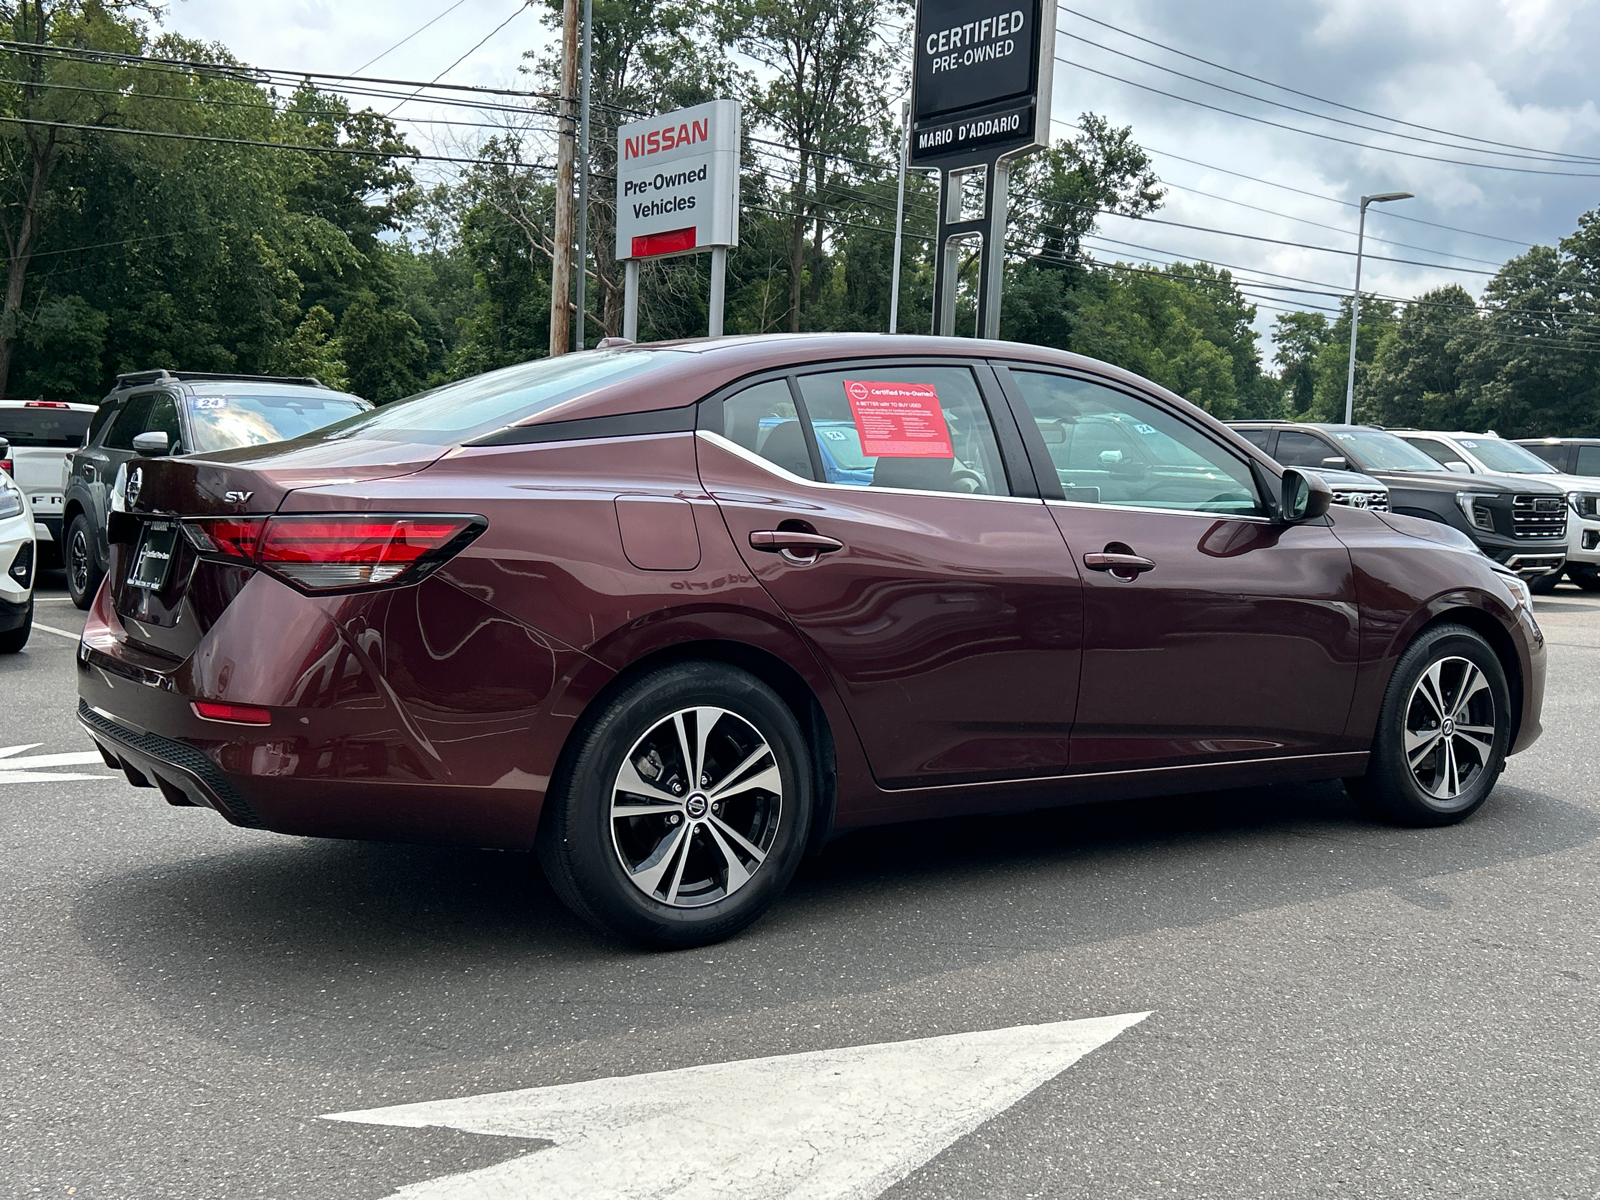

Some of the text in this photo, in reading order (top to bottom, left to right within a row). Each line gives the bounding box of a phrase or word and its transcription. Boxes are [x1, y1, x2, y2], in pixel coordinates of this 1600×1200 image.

[926, 10, 1024, 55] CERTIFIED
[932, 39, 1014, 74] PRE-OWNED
[625, 118, 708, 160] NISSAN
[919, 114, 1020, 149] MARIO D'ADDARIO
[624, 164, 707, 197] Pre-Owned
[633, 196, 696, 219] Vehicles
[201, 399, 220, 407] 24
[224, 491, 254, 503] SV
